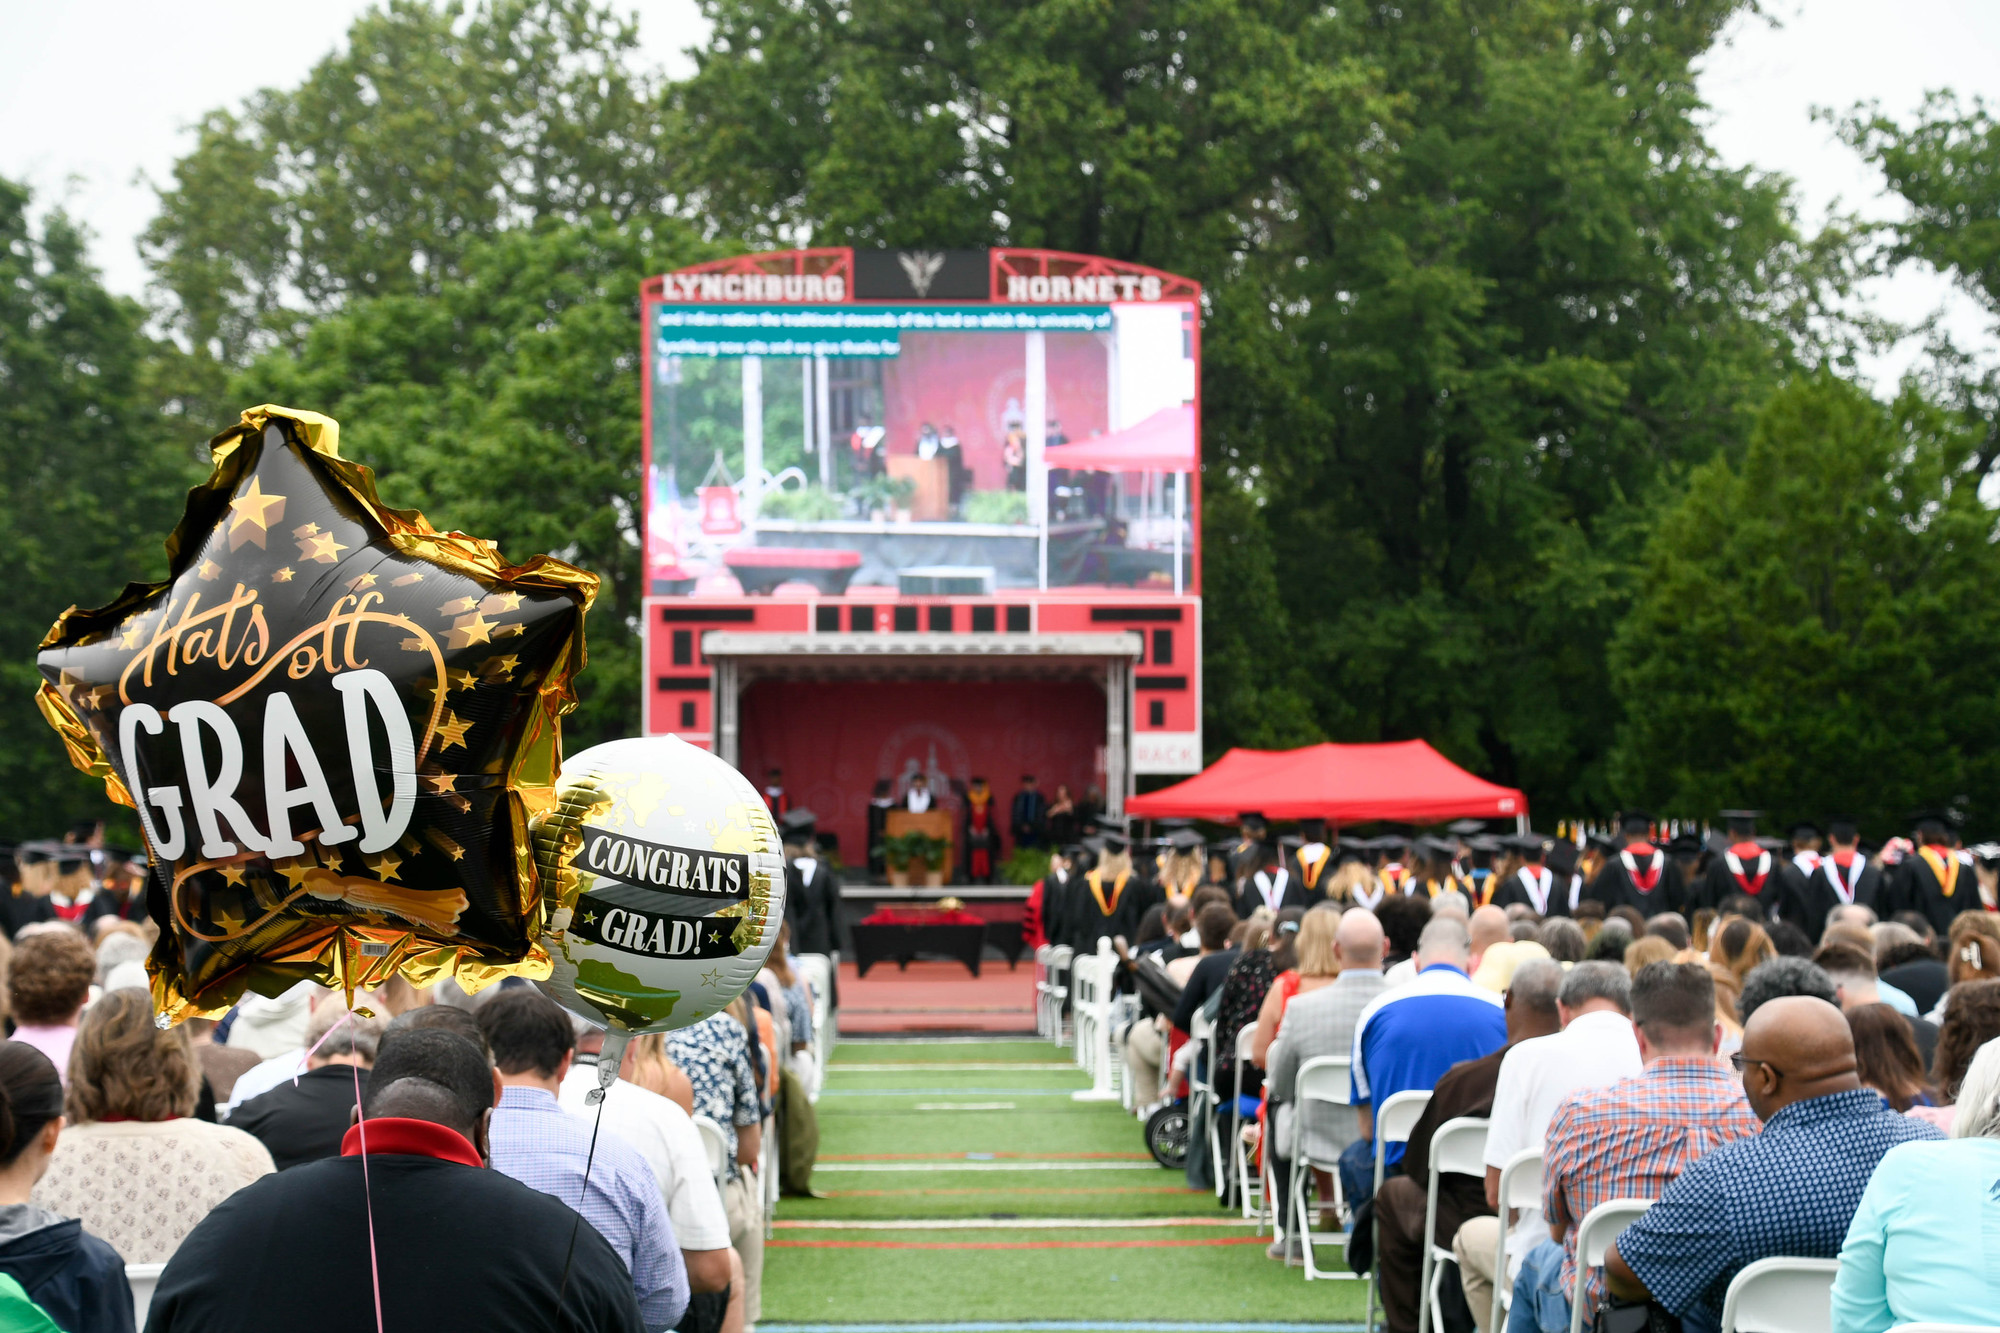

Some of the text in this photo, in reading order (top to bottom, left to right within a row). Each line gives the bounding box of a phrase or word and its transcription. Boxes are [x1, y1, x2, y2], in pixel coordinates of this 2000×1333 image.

[662, 274, 1162, 302] LYNCHBURG HORNETS
[759, 311, 781, 327] the
[898, 312, 913, 328] of
[914, 312, 934, 328] the
[934, 312, 962, 328] land
[963, 314, 980, 328] on
[981, 312, 1015, 328] which
[1015, 312, 1037, 328] the
[1095, 312, 1111, 328] of
[769, 338, 794, 355] and
[794, 341, 813, 355] we
[813, 339, 840, 357] give
[143, 583, 384, 687] Hats off
[119, 669, 417, 860] GRAD
[588, 835, 741, 894] CONGRATS
[601, 908, 703, 955] GRAD!
